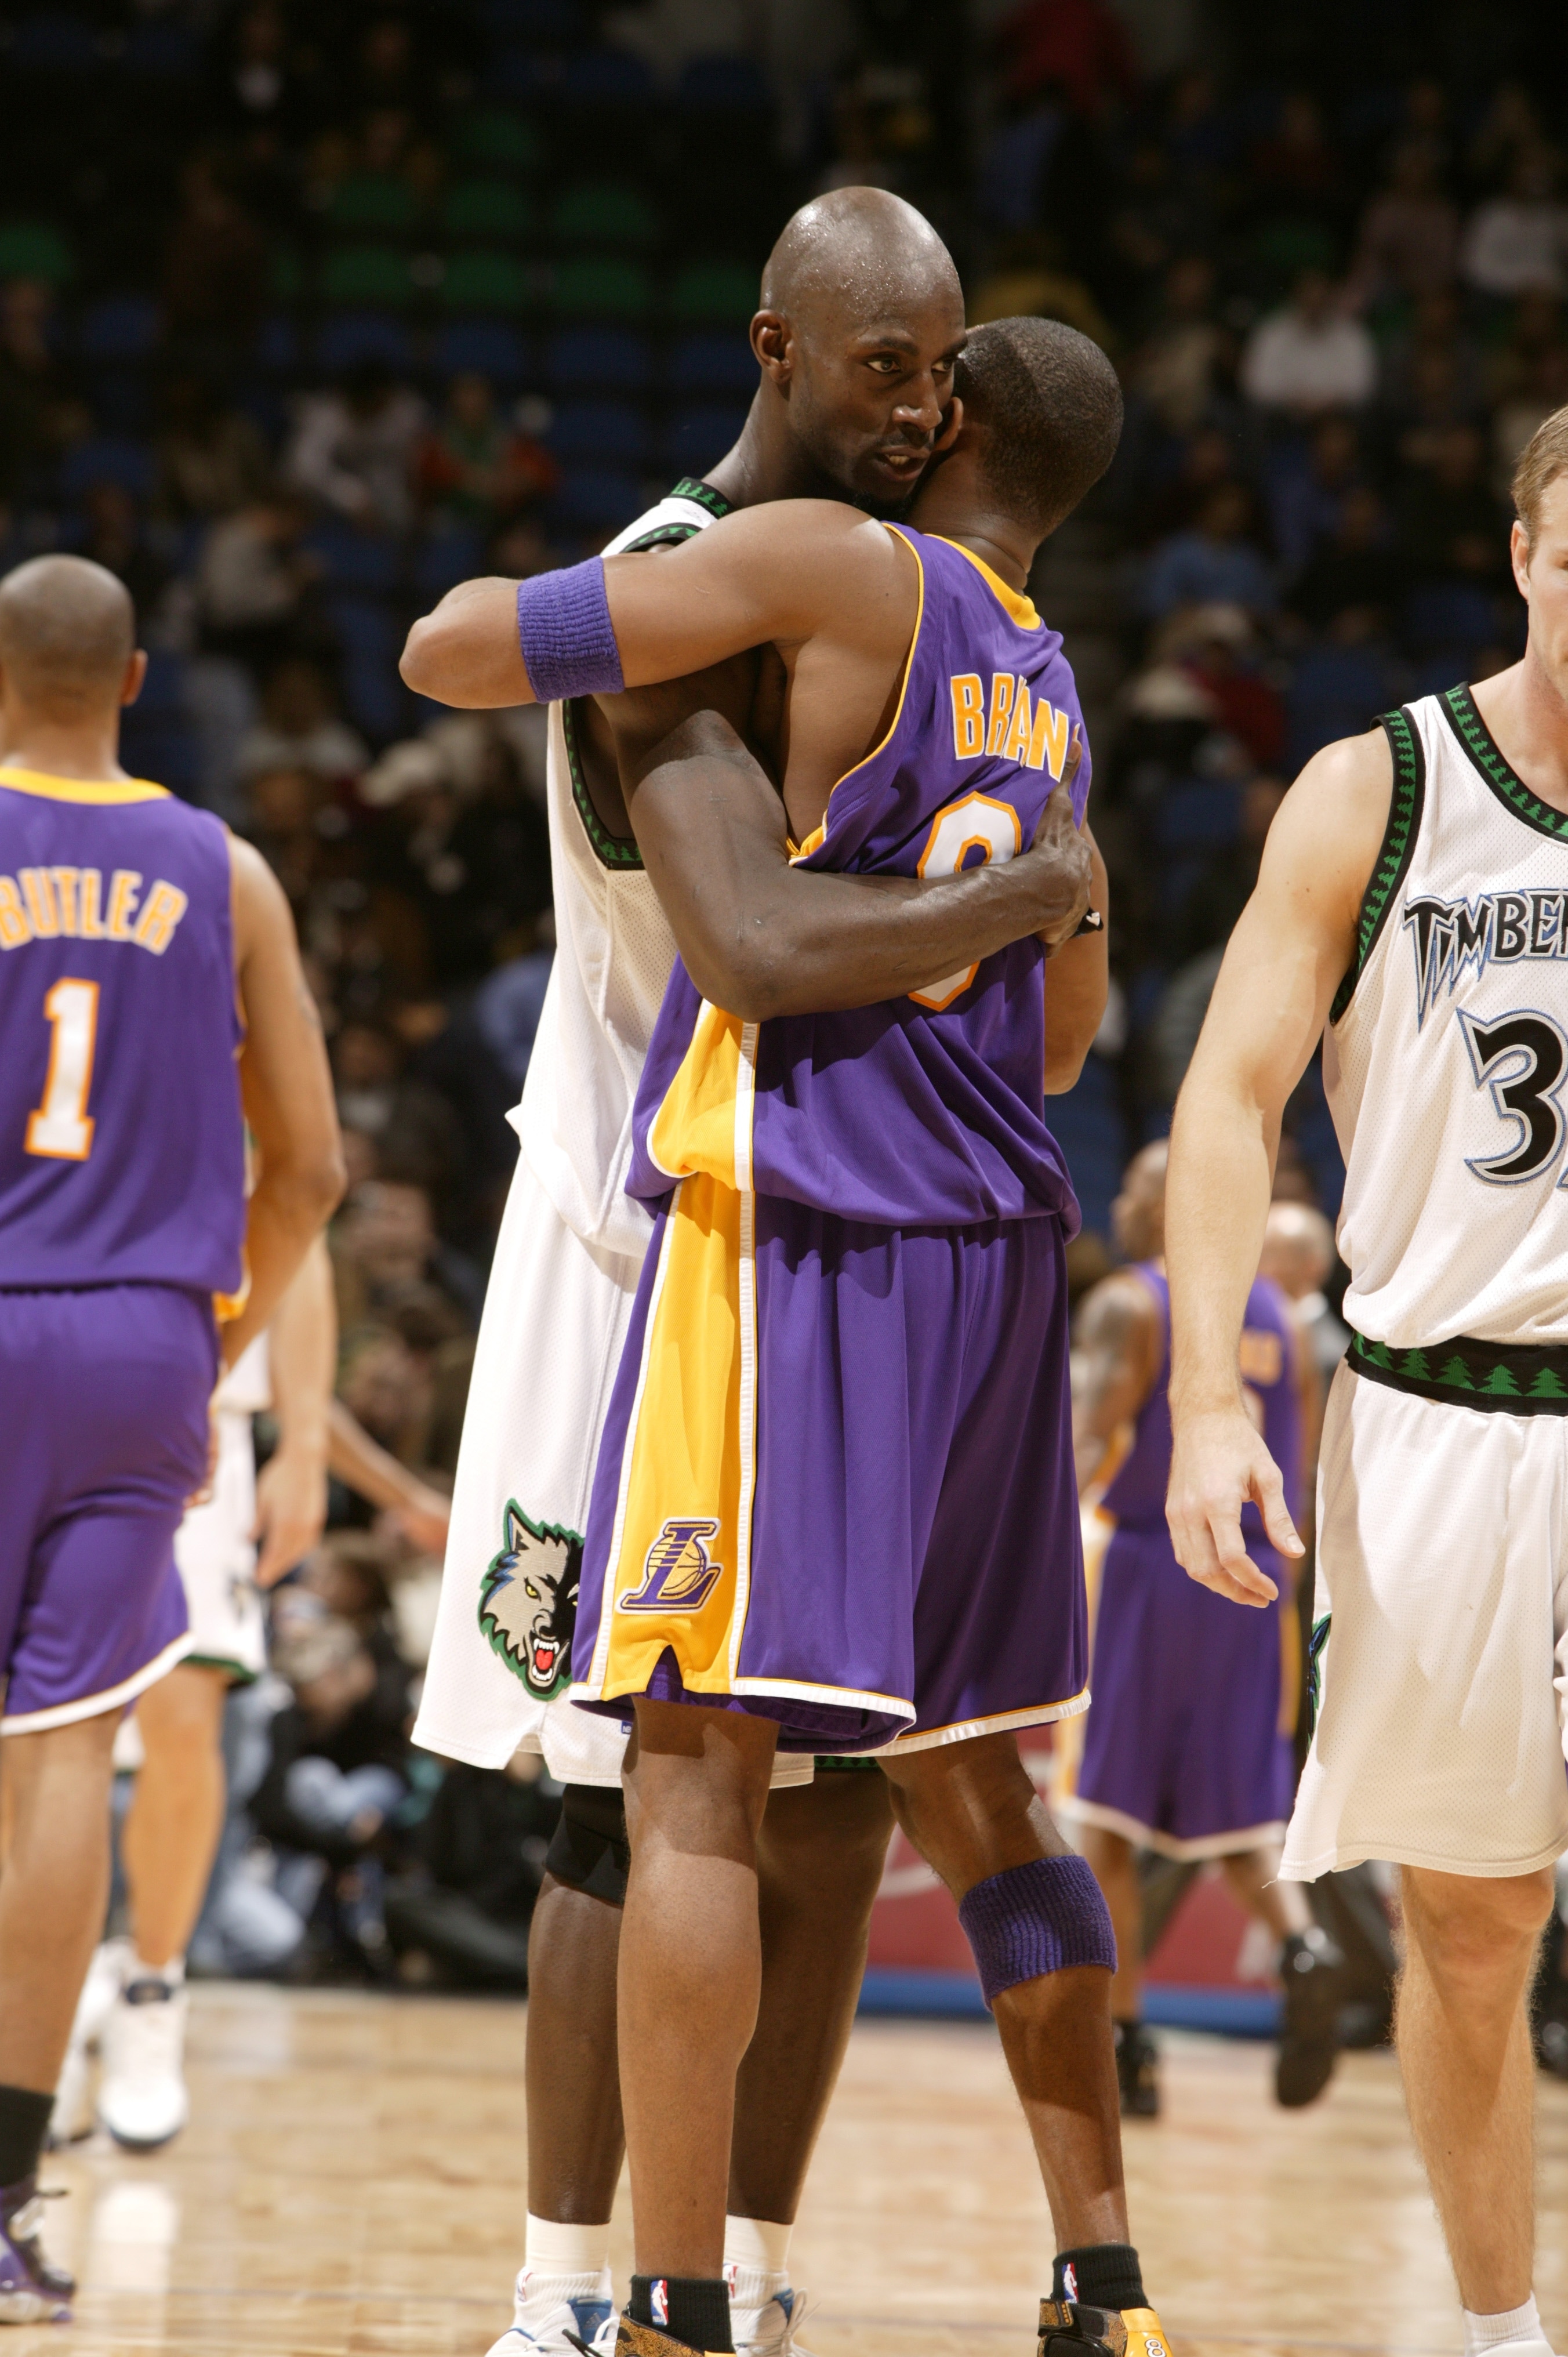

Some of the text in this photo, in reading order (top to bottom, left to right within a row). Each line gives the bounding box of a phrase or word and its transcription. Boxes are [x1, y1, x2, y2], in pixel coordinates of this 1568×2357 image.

[950, 672, 1080, 783] BRAN
[0, 865, 189, 956] BUTLER
[1402, 889, 1568, 1033] TIMBE
[25, 976, 100, 1160] 1
[1456, 1007, 1568, 1189] 3
[1144, 2338, 1167, 2357] 8
